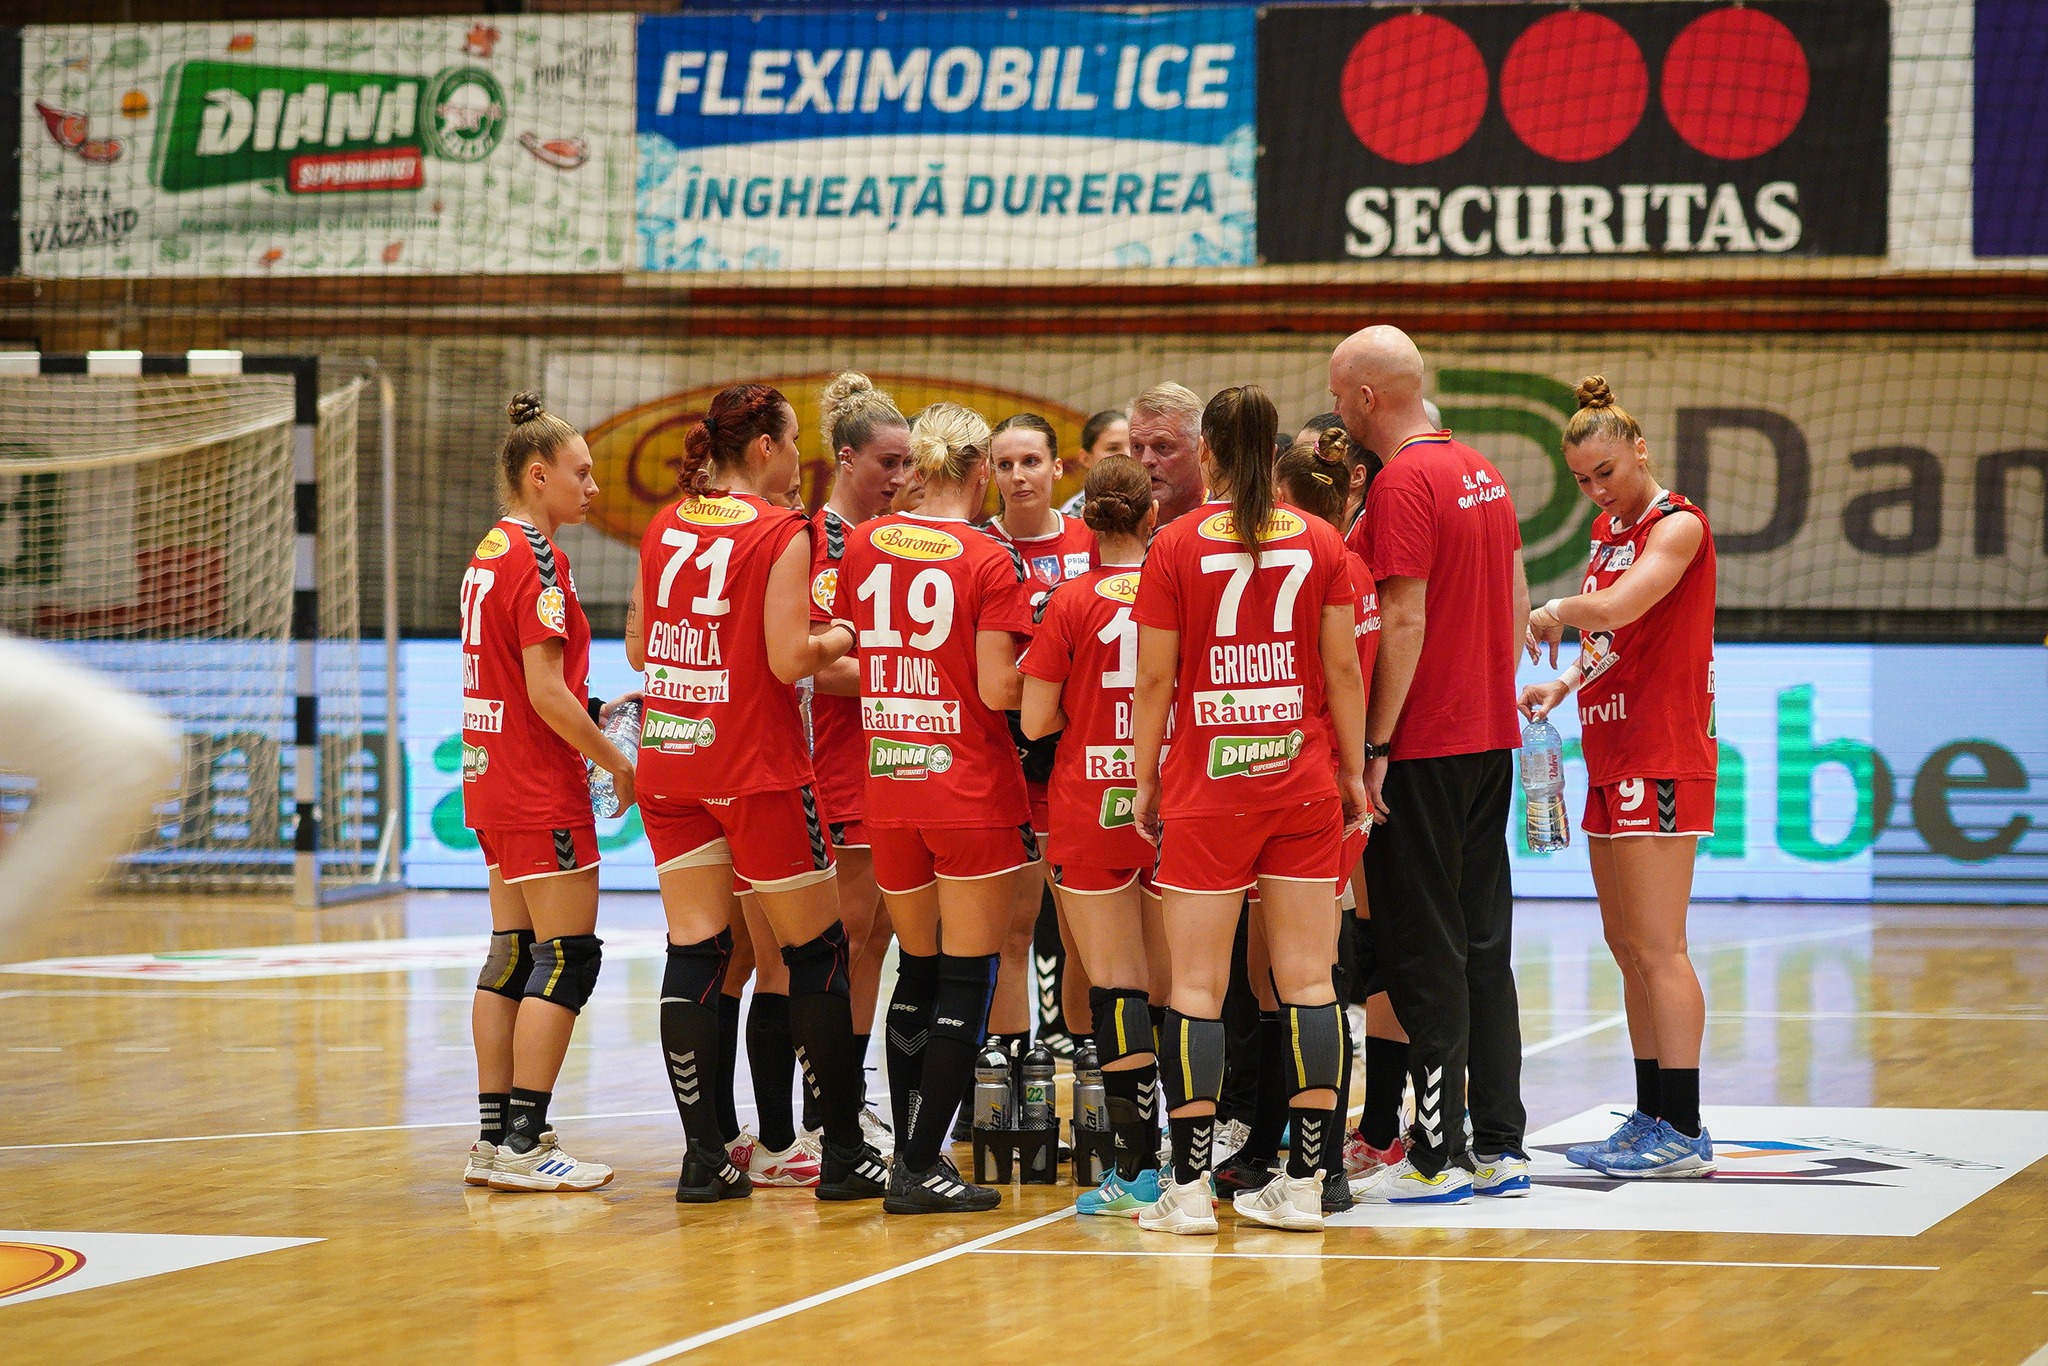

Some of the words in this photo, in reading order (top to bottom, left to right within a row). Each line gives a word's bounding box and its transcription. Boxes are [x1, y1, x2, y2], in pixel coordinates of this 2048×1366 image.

[656, 47, 1099, 116] FLEXIMOBIL
[1113, 44, 1236, 111] ICE
[197, 83, 419, 156] DIANA
[299, 156, 417, 187] SUPERMARKET
[682, 163, 947, 231] ÎNGHEAȚĂ
[962, 172, 1216, 217] DUREREA
[1345, 181, 1801, 257] SECURITAS
[880, 528, 952, 555] Boromir
[656, 527, 735, 616] 71
[1200, 549, 1313, 637] 77
[857, 563, 955, 652] 19
[647, 618, 722, 666] GOGÎRLĂ
[1097, 607, 1138, 689] 1
[1209, 641, 1297, 685] GRIGORE
[870, 654, 888, 693] DE
[892, 655, 940, 696] JONG
[645, 718, 698, 740] DIANA
[875, 747, 927, 766] DIANA
[1221, 739, 1286, 766] DIANA
[1252, 760, 1287, 773] SUPERMARKET
[1618, 777, 1645, 812] 9
[1026, 1086, 1044, 1103] 22
